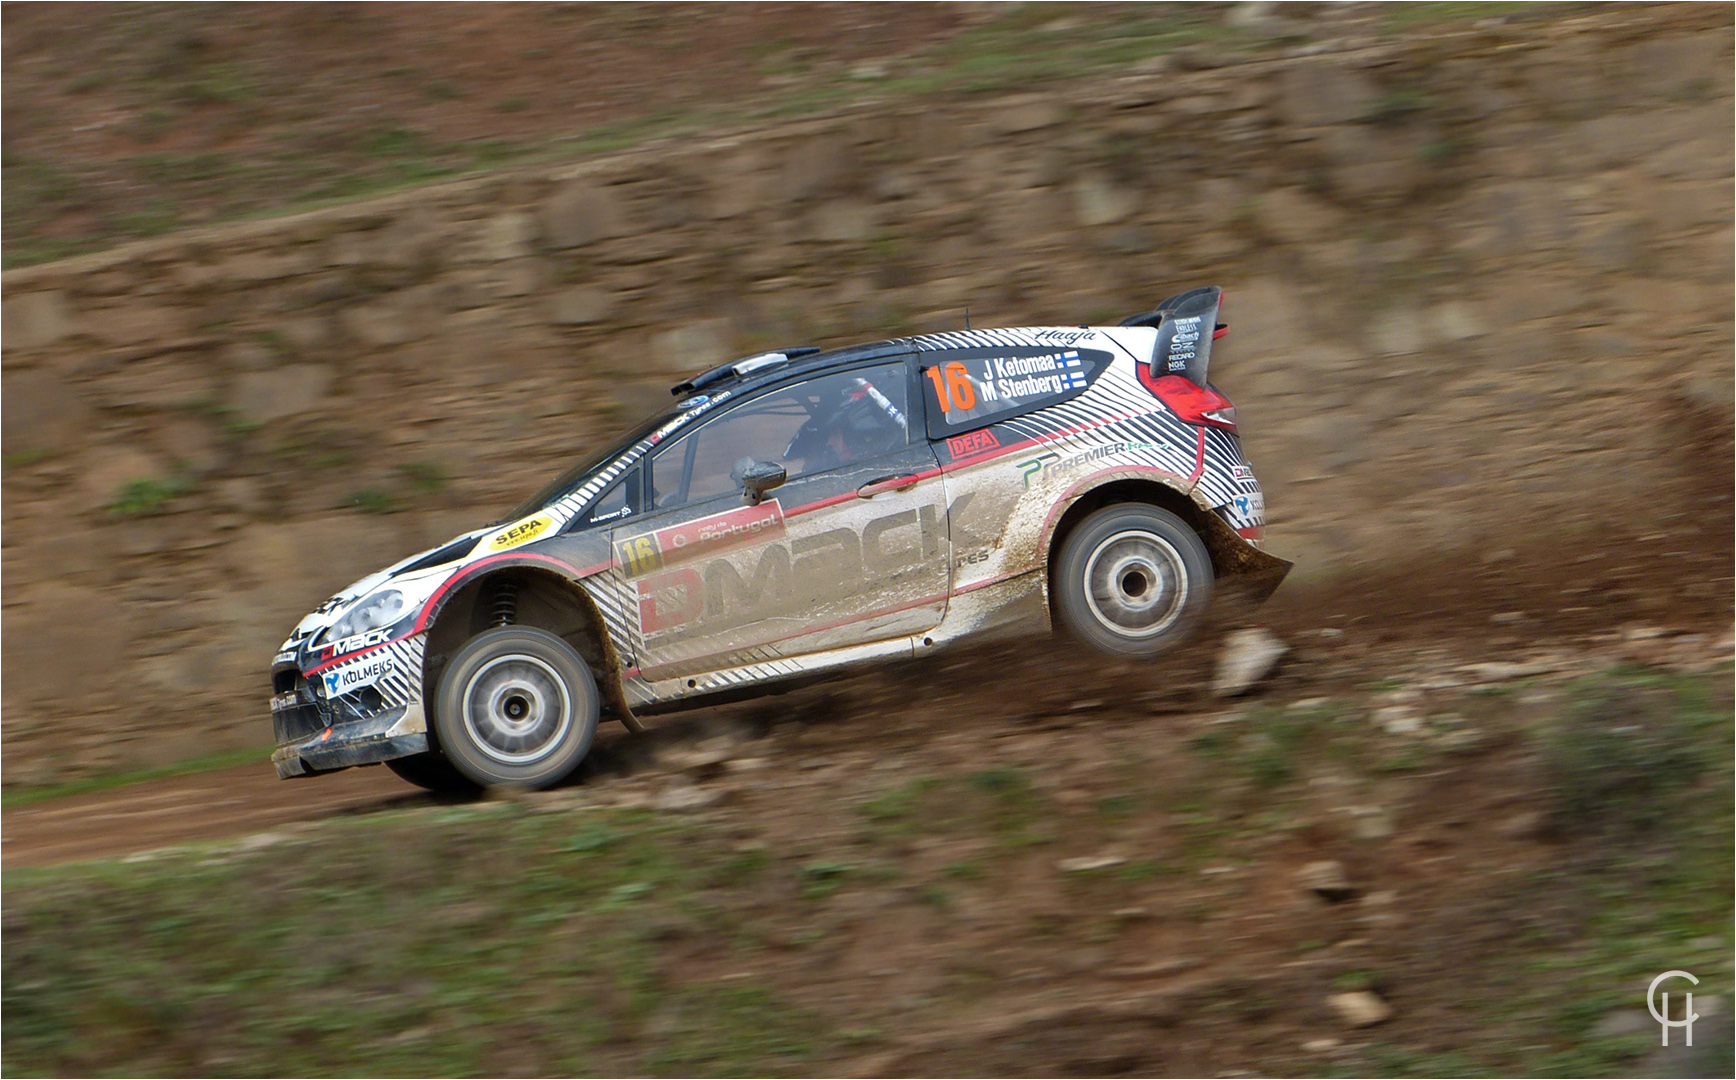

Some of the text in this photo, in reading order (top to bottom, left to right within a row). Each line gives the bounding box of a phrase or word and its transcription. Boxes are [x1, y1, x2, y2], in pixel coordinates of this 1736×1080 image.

[1034, 329, 1097, 345] Haaja
[983, 353, 1056, 381] J Ketomaa
[1168, 352, 1195, 361] RECARO
[927, 361, 976, 413] 16
[980, 373, 1062, 402] M Stenberg
[952, 431, 994, 455] DEFA
[1050, 441, 1126, 479] PREMIER
[495, 519, 543, 545] SEPA
[700, 514, 779, 541] Portugal
[622, 537, 660, 576] 16
[341, 659, 394, 687] KOLMEKS
